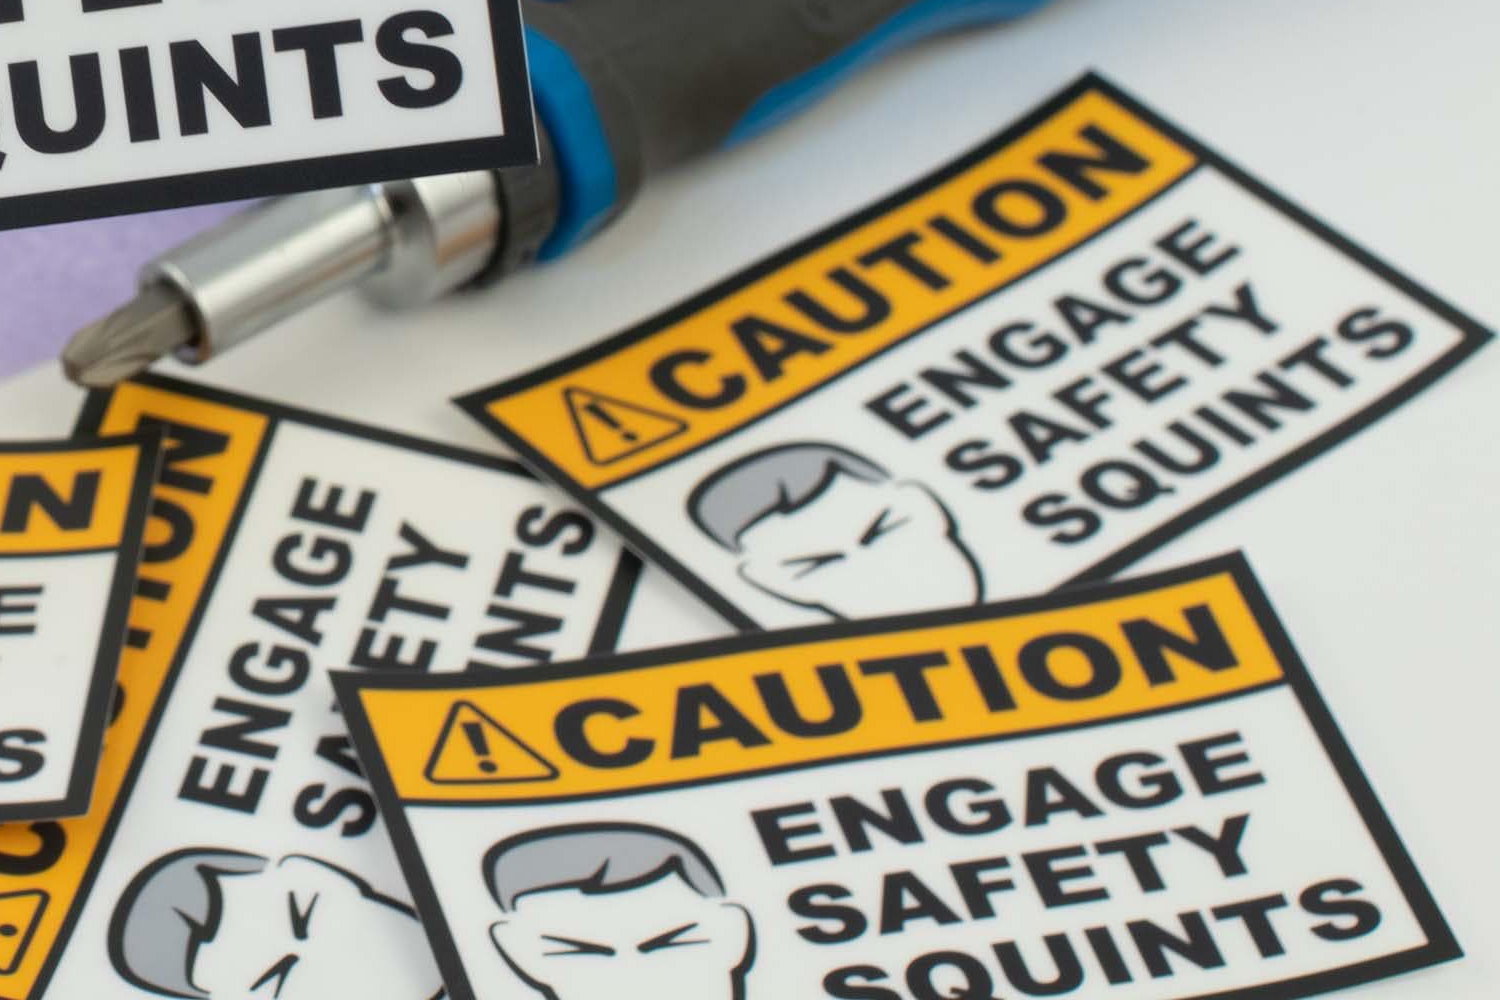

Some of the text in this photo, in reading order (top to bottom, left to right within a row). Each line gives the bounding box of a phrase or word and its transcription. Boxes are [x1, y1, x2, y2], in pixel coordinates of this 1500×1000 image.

[648, 123, 1152, 413] CAUTION
[864, 218, 1240, 440] ENGAGE
[944, 284, 1280, 490] SAFETY
[1021, 306, 1417, 545] SQUINTS
[178, 477, 376, 815] ENGAGE
[293, 522, 469, 838] SETY
[553, 604, 1239, 769] CAUTION
[750, 731, 1265, 866] ENGAGE
[786, 814, 1250, 945] SAFETY
[823, 878, 1382, 1000] SQUINTS
